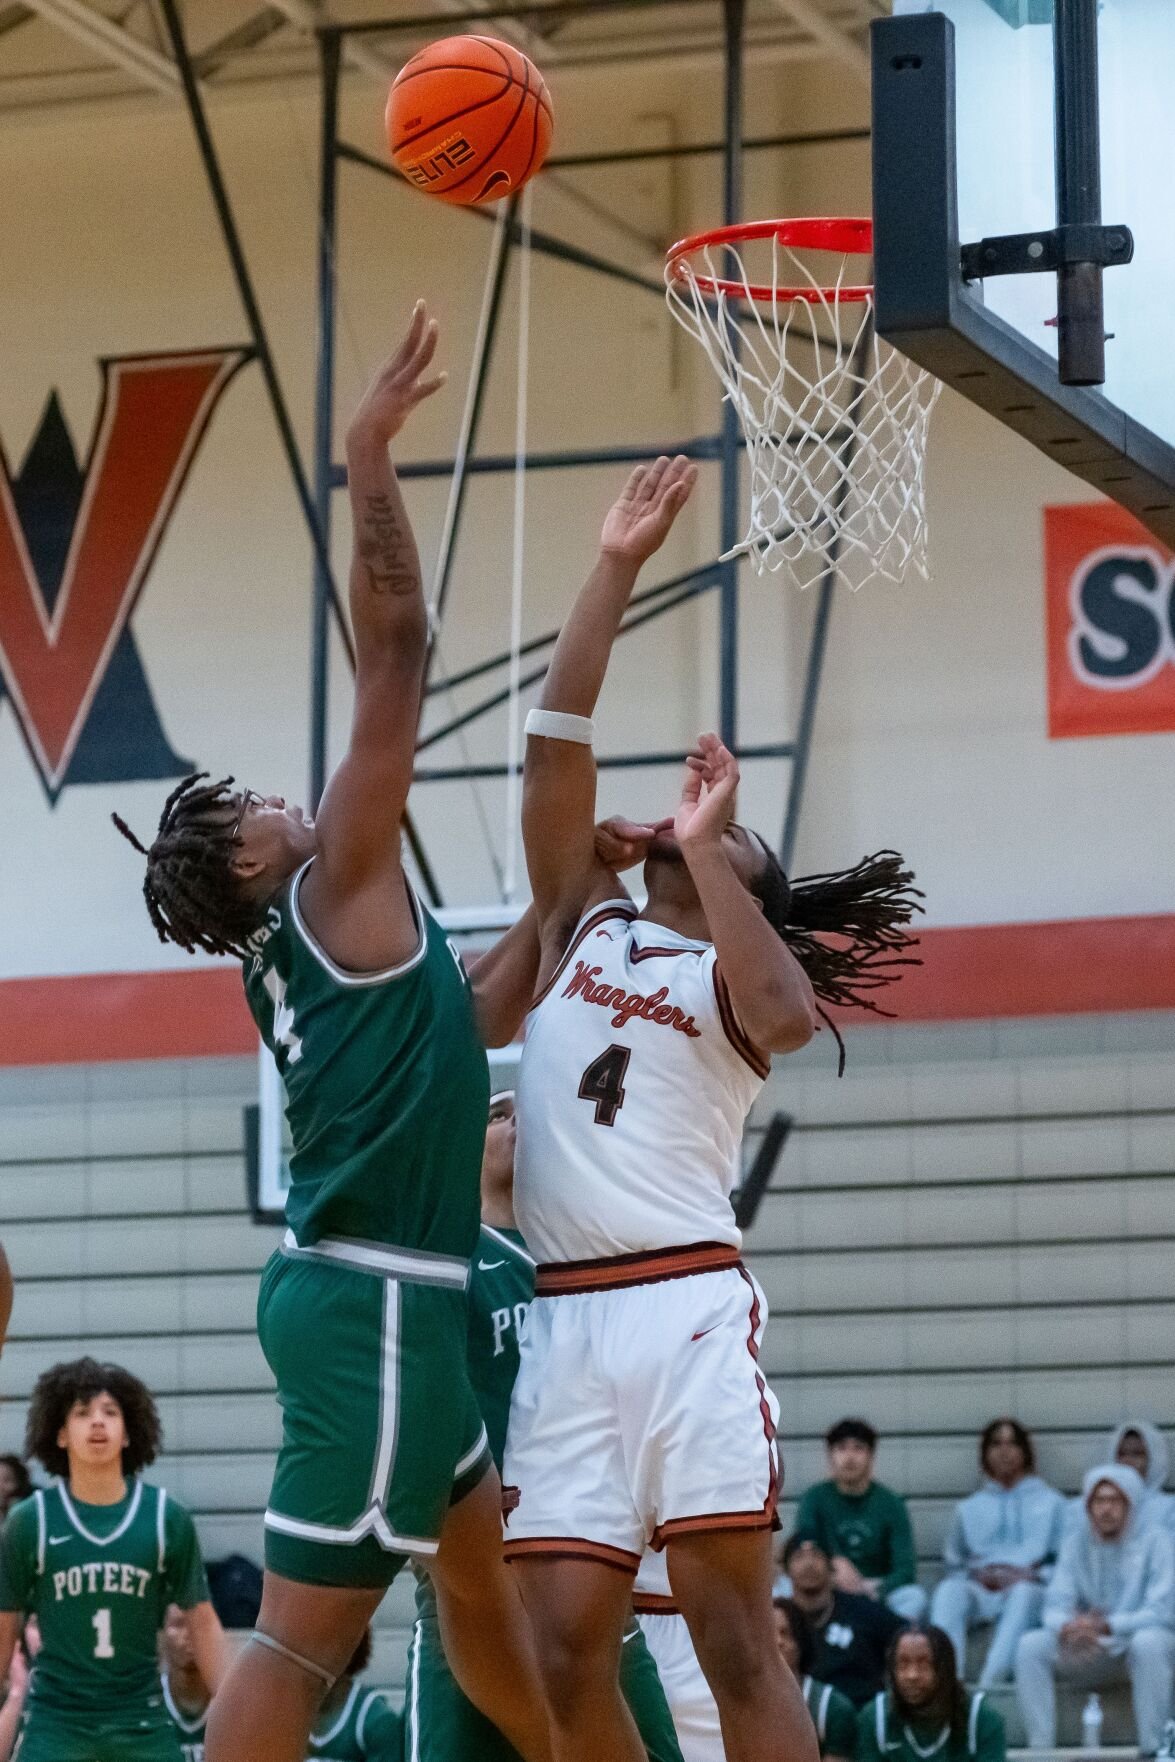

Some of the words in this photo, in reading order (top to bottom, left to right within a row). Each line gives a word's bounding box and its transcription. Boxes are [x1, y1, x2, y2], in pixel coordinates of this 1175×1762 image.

[406, 136, 476, 185] ELITE
[561, 960, 701, 1038] Wranglers
[578, 1043, 631, 1127] 4
[53, 1562, 151, 1600] POTEET
[92, 1608, 114, 1658] 1
